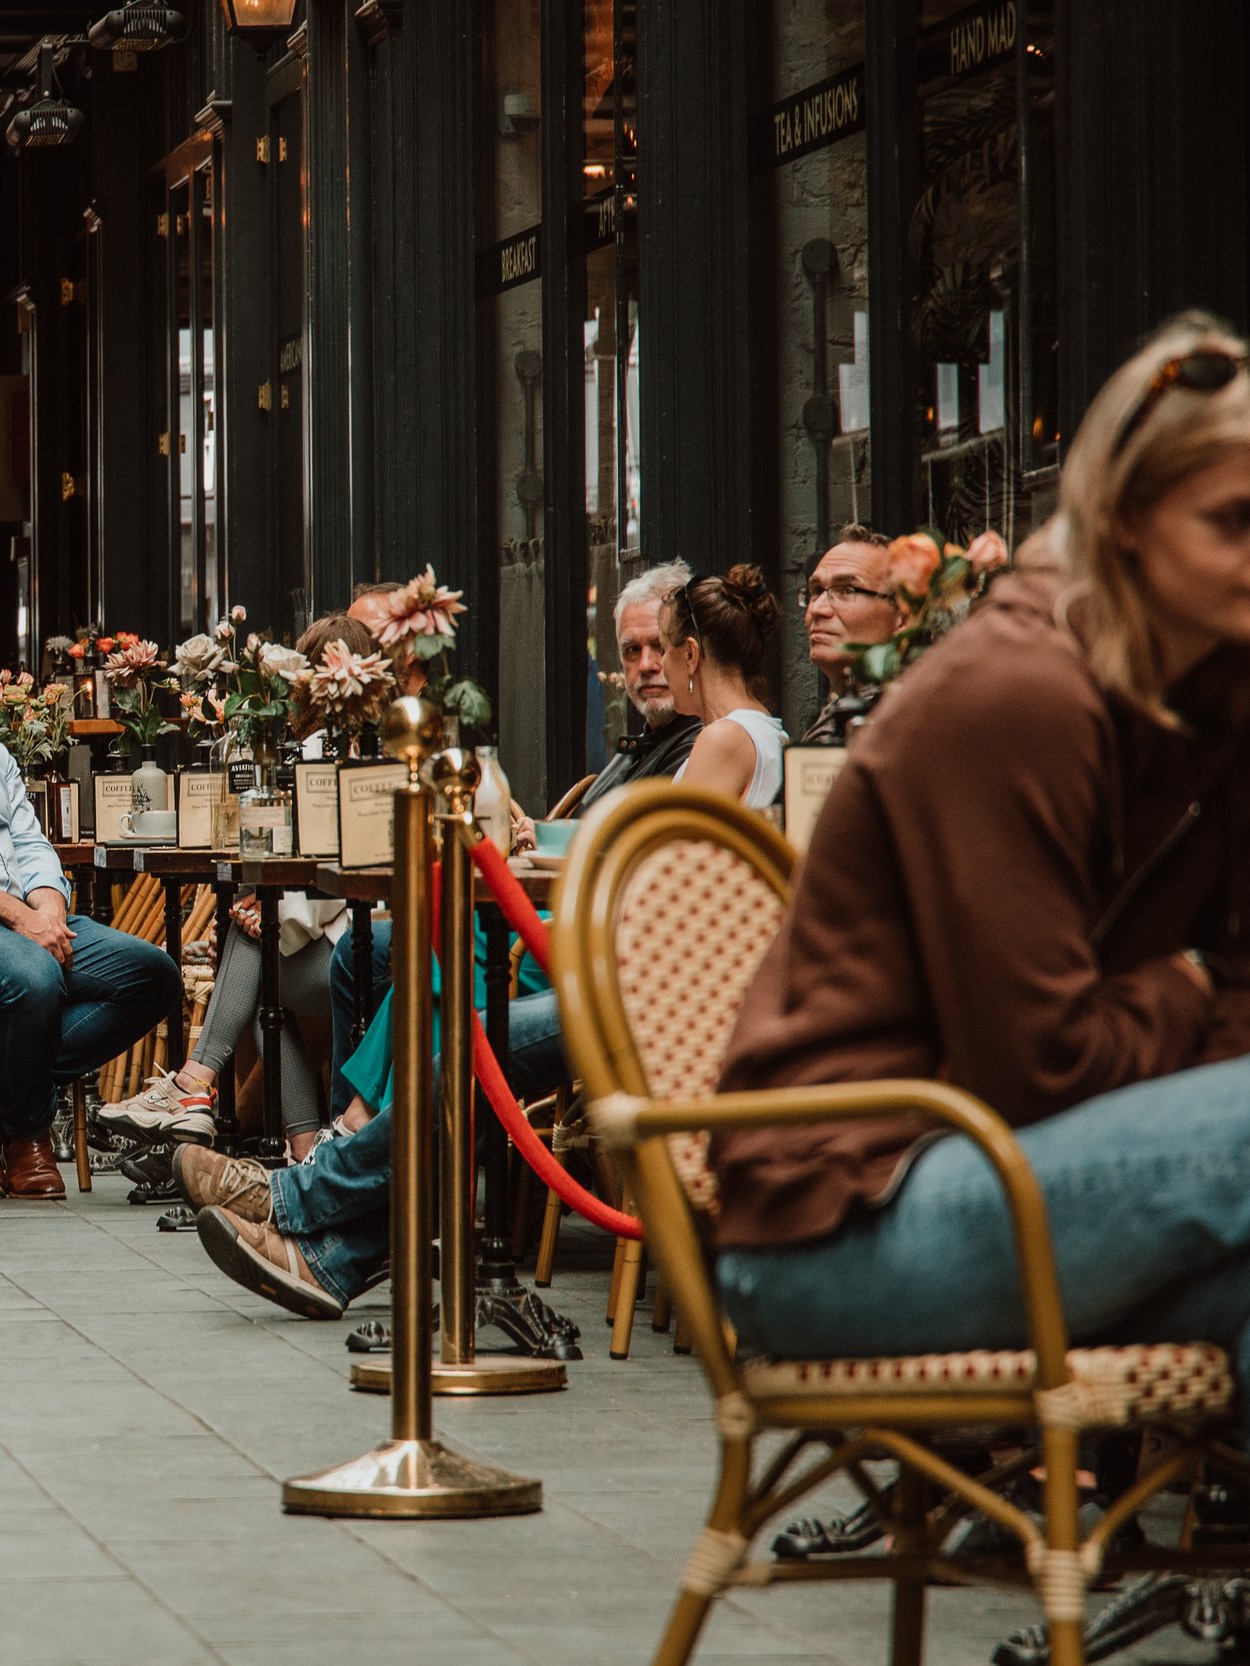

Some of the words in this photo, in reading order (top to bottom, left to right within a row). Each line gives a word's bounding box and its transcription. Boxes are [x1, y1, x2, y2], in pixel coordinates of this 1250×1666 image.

[951, 16, 985, 76] HAND
[774, 109, 793, 156] TEA
[794, 105, 803, 148] &
[804, 77, 859, 143] INFUSIONS
[501, 235, 536, 284] BREAKFAST
